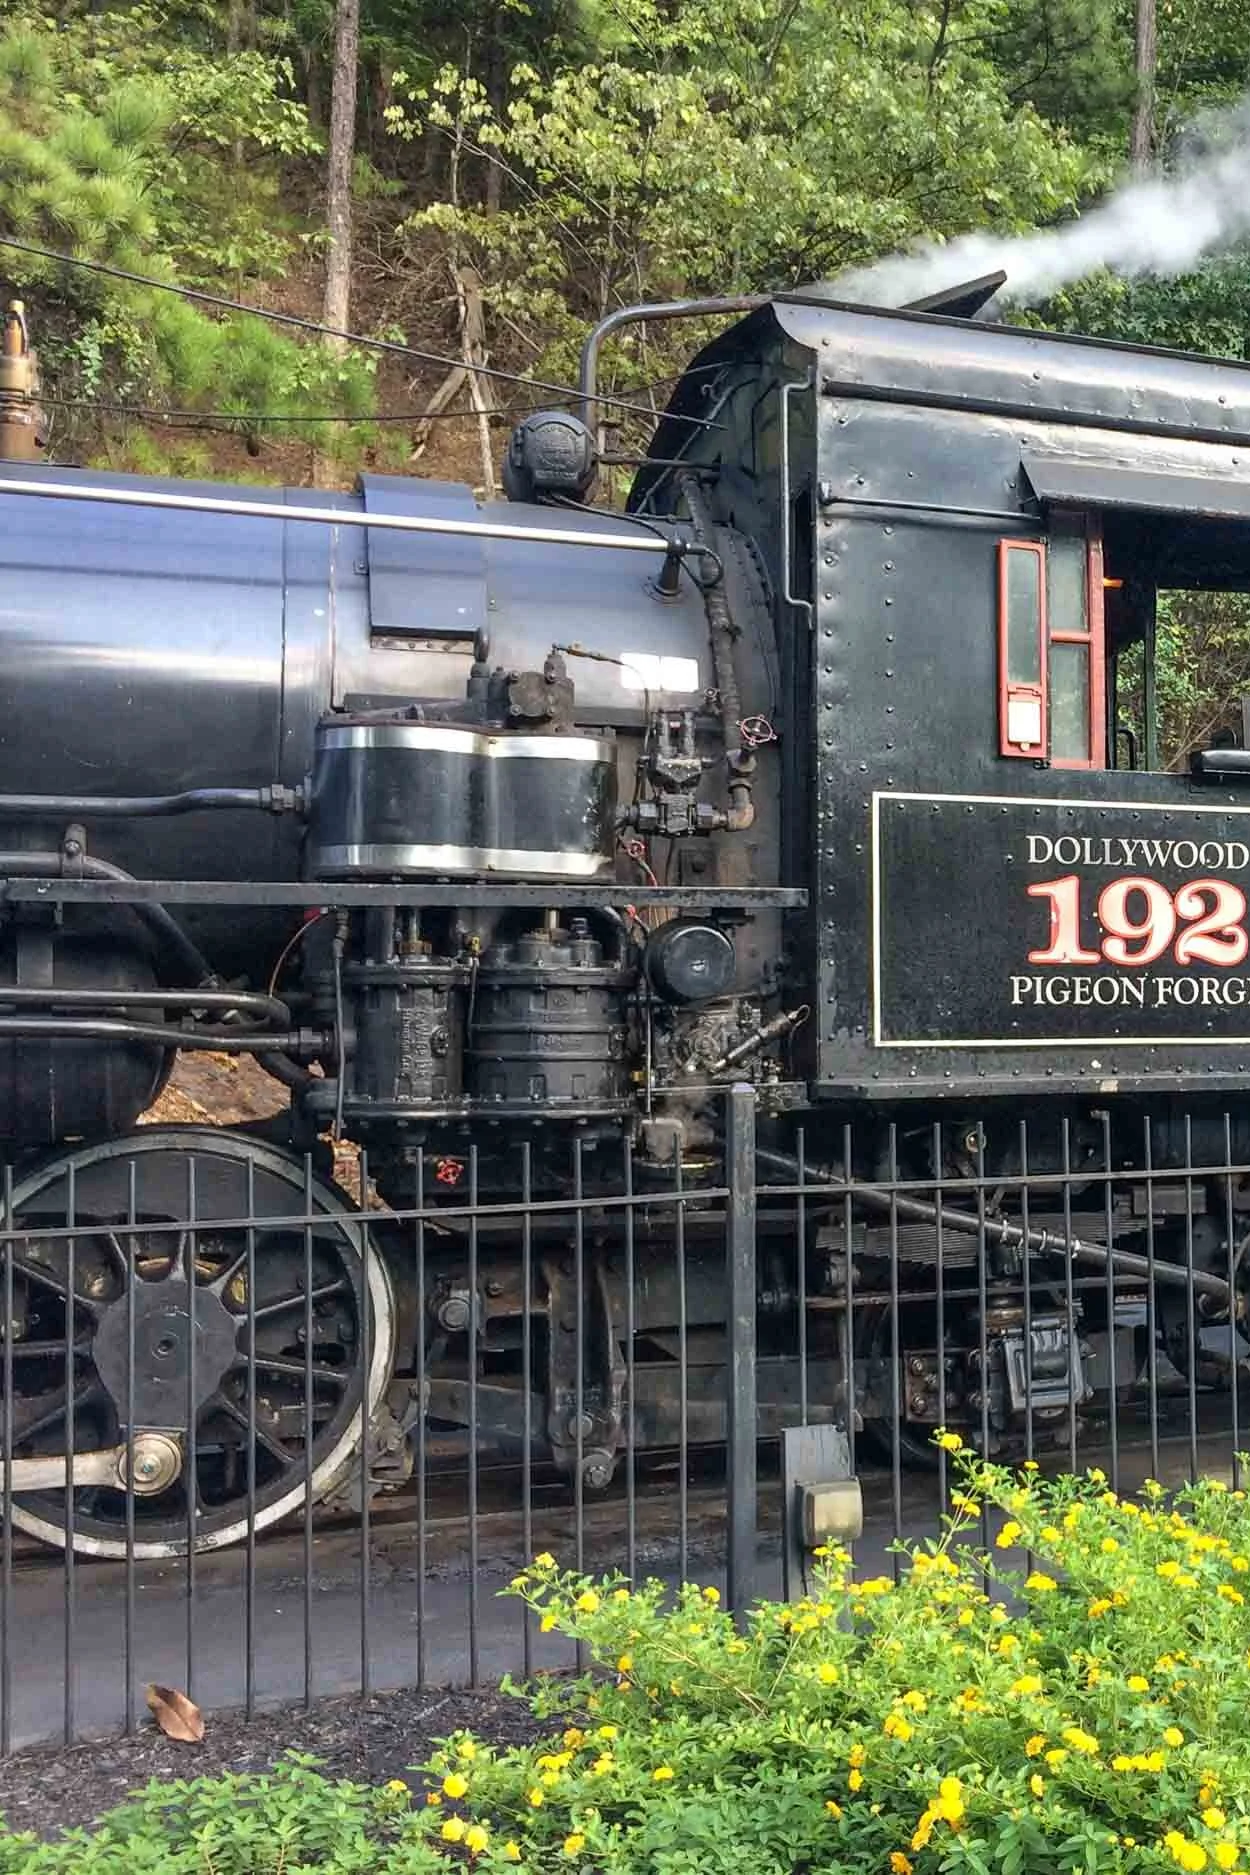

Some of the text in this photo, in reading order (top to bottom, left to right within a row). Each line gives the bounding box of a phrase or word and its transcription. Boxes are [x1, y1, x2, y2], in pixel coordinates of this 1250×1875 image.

[1026, 834, 1250, 870] DOLLYWOOD
[1027, 875, 1249, 966] 192
[1010, 975, 1146, 1006] PIGEON
